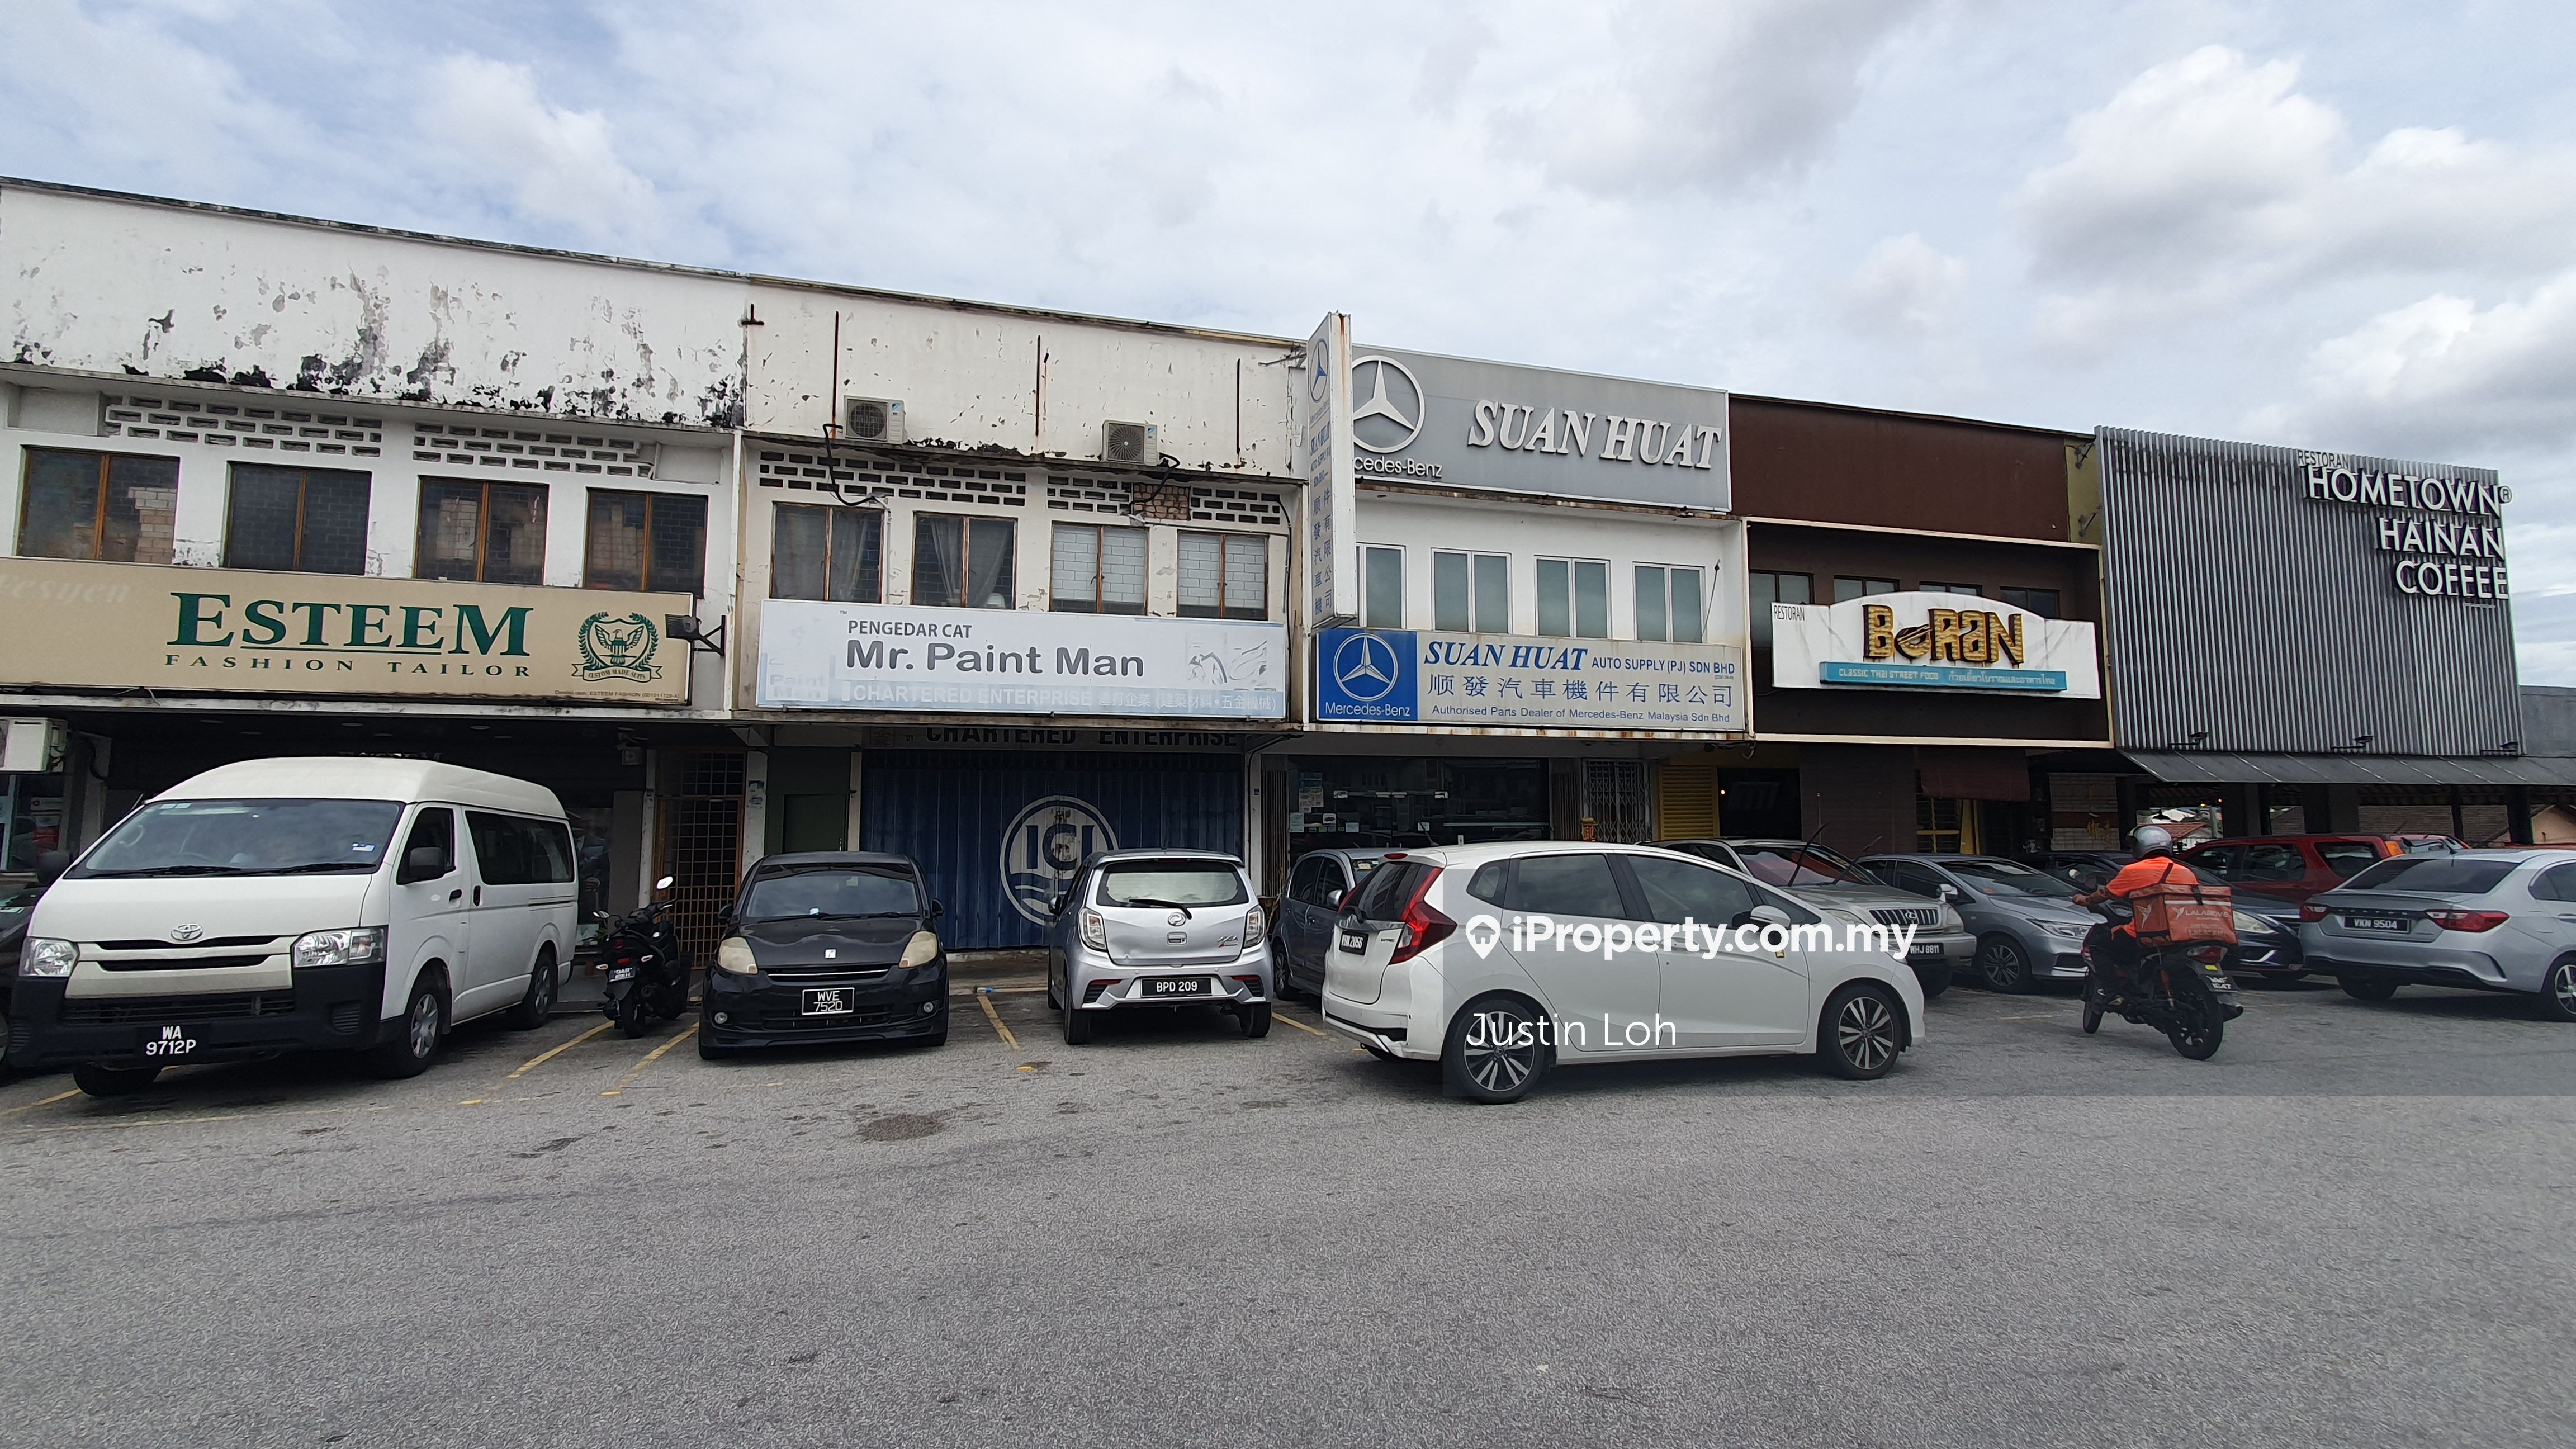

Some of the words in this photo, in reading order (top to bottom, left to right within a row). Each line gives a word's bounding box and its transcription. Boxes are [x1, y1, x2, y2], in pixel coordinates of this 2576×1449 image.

[1467, 400, 1596, 457] SUAN
[1600, 415, 1722, 469] HUAT
[1353, 456, 1443, 478] cedes-Benz
[2298, 449, 2348, 468] RESTORAN
[2379, 517, 2505, 559] HAINAN
[2396, 560, 2509, 599] COFFEE
[1774, 604, 1805, 622] RESTORAN
[167, 591, 534, 656] ESTEEM
[848, 620, 938, 637] PENGEDAR
[942, 624, 973, 639] CAT
[165, 654, 354, 671] FASHION
[387, 661, 531, 678] TAILOR
[846, 639, 913, 670] Mr.
[927, 642, 1043, 674] Paint
[1056, 647, 1144, 678] Man
[1424, 641, 1505, 667] SUAN
[1507, 645, 1588, 671] HUAT
[1592, 656, 1622, 670] AUTO
[1689, 661, 1710, 673] SDN
[1713, 662, 1735, 674] BHD
[588, 669, 611, 679] CUSTOM
[612, 668, 629, 676] MADE
[631, 670, 646, 680] SUITS
[1920, 671, 1939, 680] FOOD
[853, 684, 972, 703] CHARTERED
[985, 688, 1092, 707] ENTERPRISE
[1325, 702, 1410, 717] Mercedes-Benz
[1432, 704, 1487, 716] Authorised
[1491, 707, 1517, 716] Parts
[1521, 708, 1554, 717] Dealer
[1556, 708, 1565, 717] of
[1569, 708, 1644, 719] Mercedes-Benz
[1648, 711, 1688, 723] Malaysia
[1691, 712, 1709, 722] Sdn
[1712, 713, 1730, 723] Bhd
[925, 727, 1077, 745] CHARTERED
[2354, 918, 2371, 927] VKN
[2373, 920, 2397, 929] 9504
[1156, 982, 1176, 992] BPD
[1178, 981, 1197, 992] 209
[817, 991, 840, 1002] WVE
[813, 1001, 843, 1012] 7520
[162, 1025, 182, 1040] WA
[146, 1039, 197, 1055] 9712P
